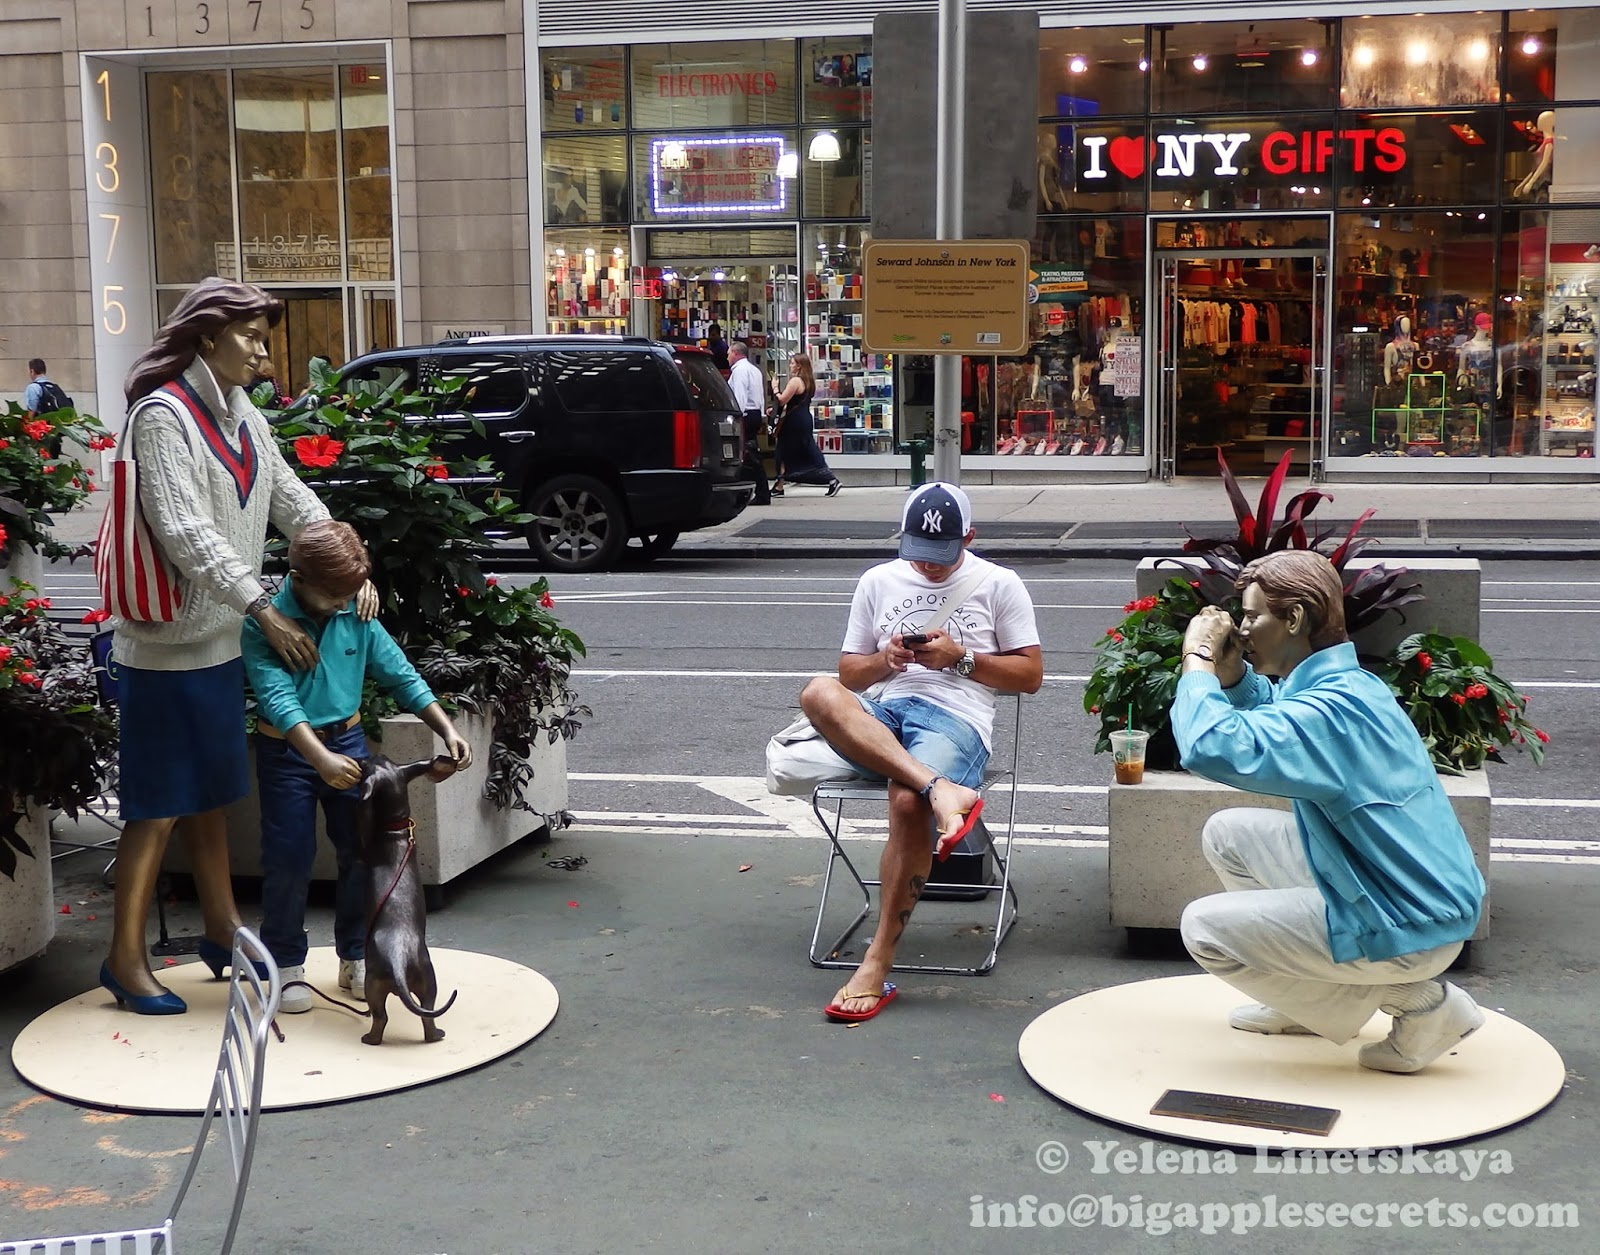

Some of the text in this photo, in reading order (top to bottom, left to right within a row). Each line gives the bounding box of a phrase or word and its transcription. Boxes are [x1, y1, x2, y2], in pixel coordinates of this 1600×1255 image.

[145, 0, 316, 38] 1375
[656, 71, 777, 98] ELECTRONICS
[1082, 127, 1407, 179] I NY GIFTS
[95, 70, 128, 336] 1375
[876, 257, 1017, 267] Seward Johnson in New York
[921, 508, 944, 533] NY
[879, 593, 978, 633] AÉROPOSALE
